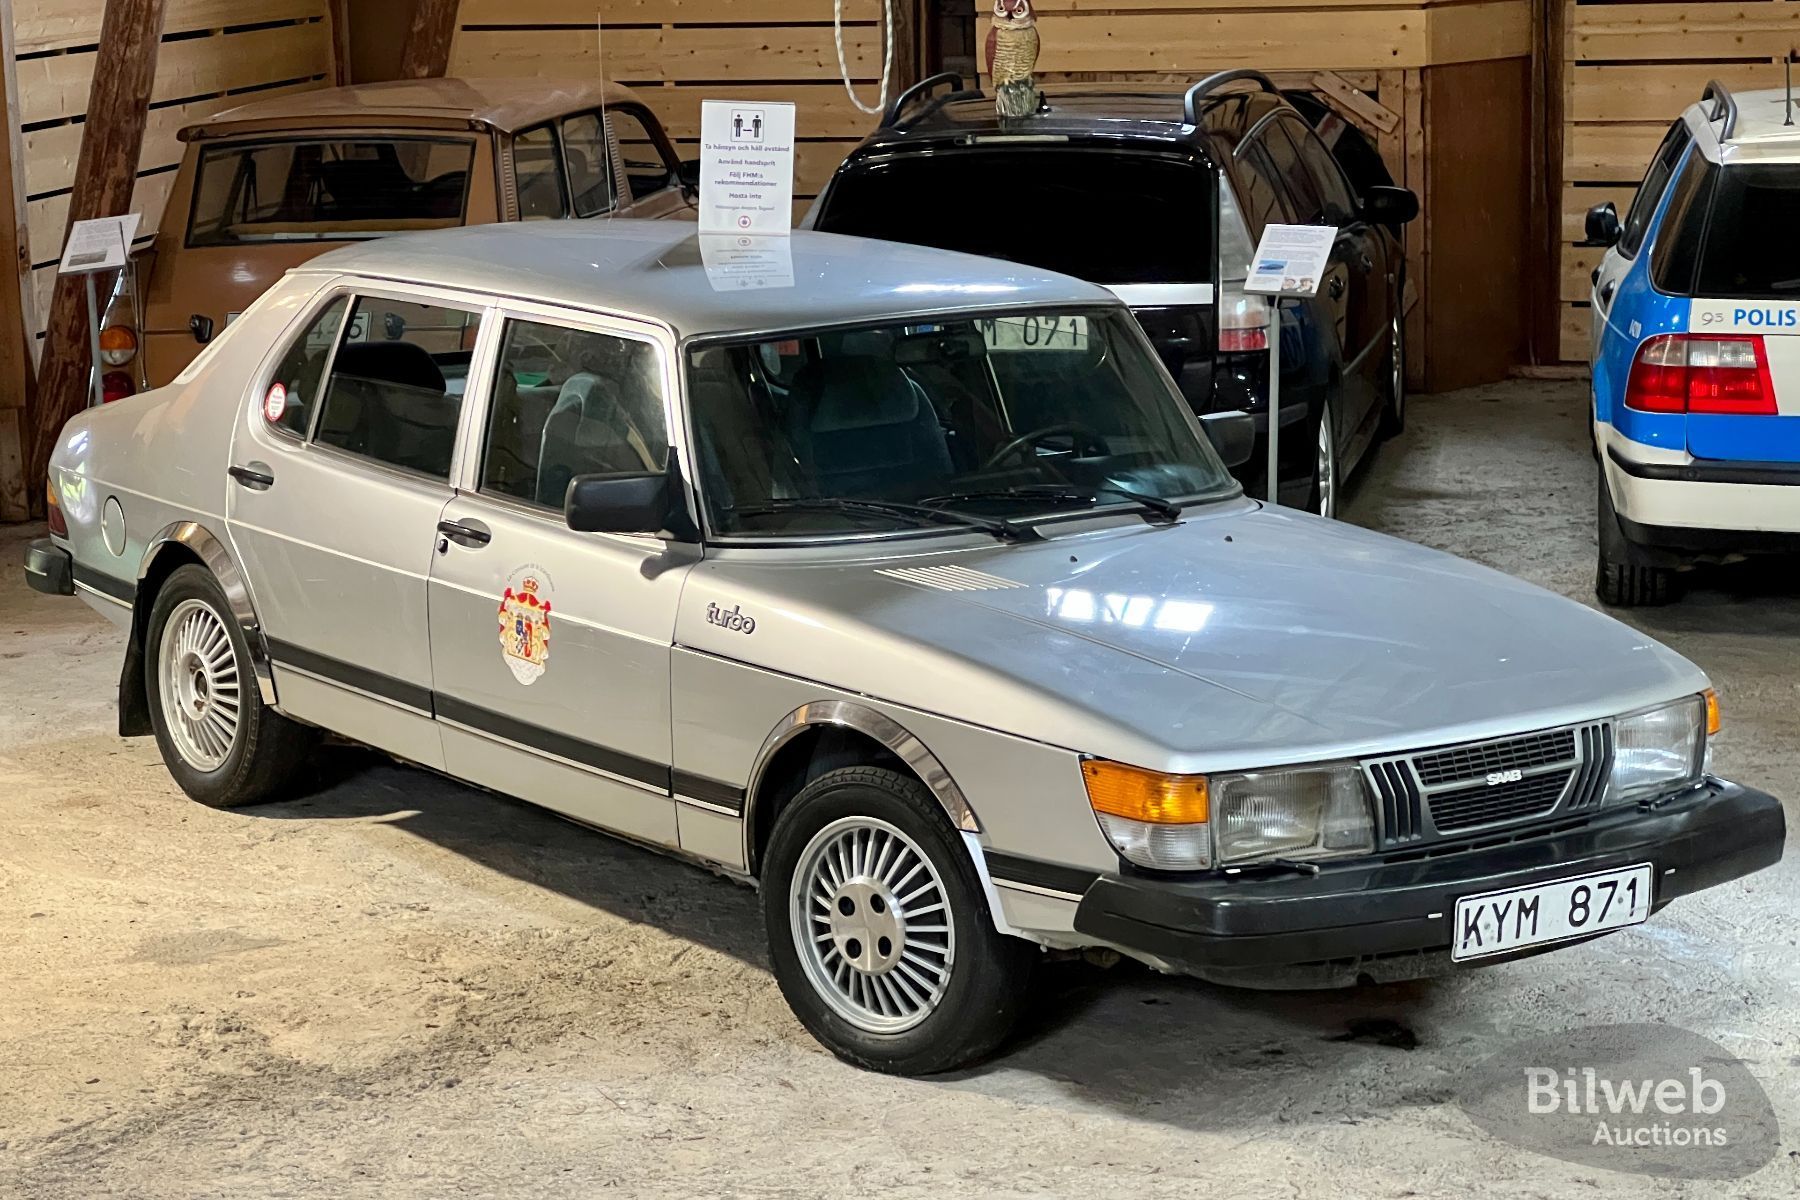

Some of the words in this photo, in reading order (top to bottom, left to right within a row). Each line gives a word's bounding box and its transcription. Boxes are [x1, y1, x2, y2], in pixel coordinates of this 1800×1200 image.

[729, 171, 741, 179] Följ
[1734, 309, 1797, 326] POLIS
[1023, 316, 1078, 346] 071
[706, 602, 756, 635] turbo
[1486, 769, 1522, 786] SAAB
[1463, 894, 1540, 950] KYM
[1568, 877, 1638, 928] 871
